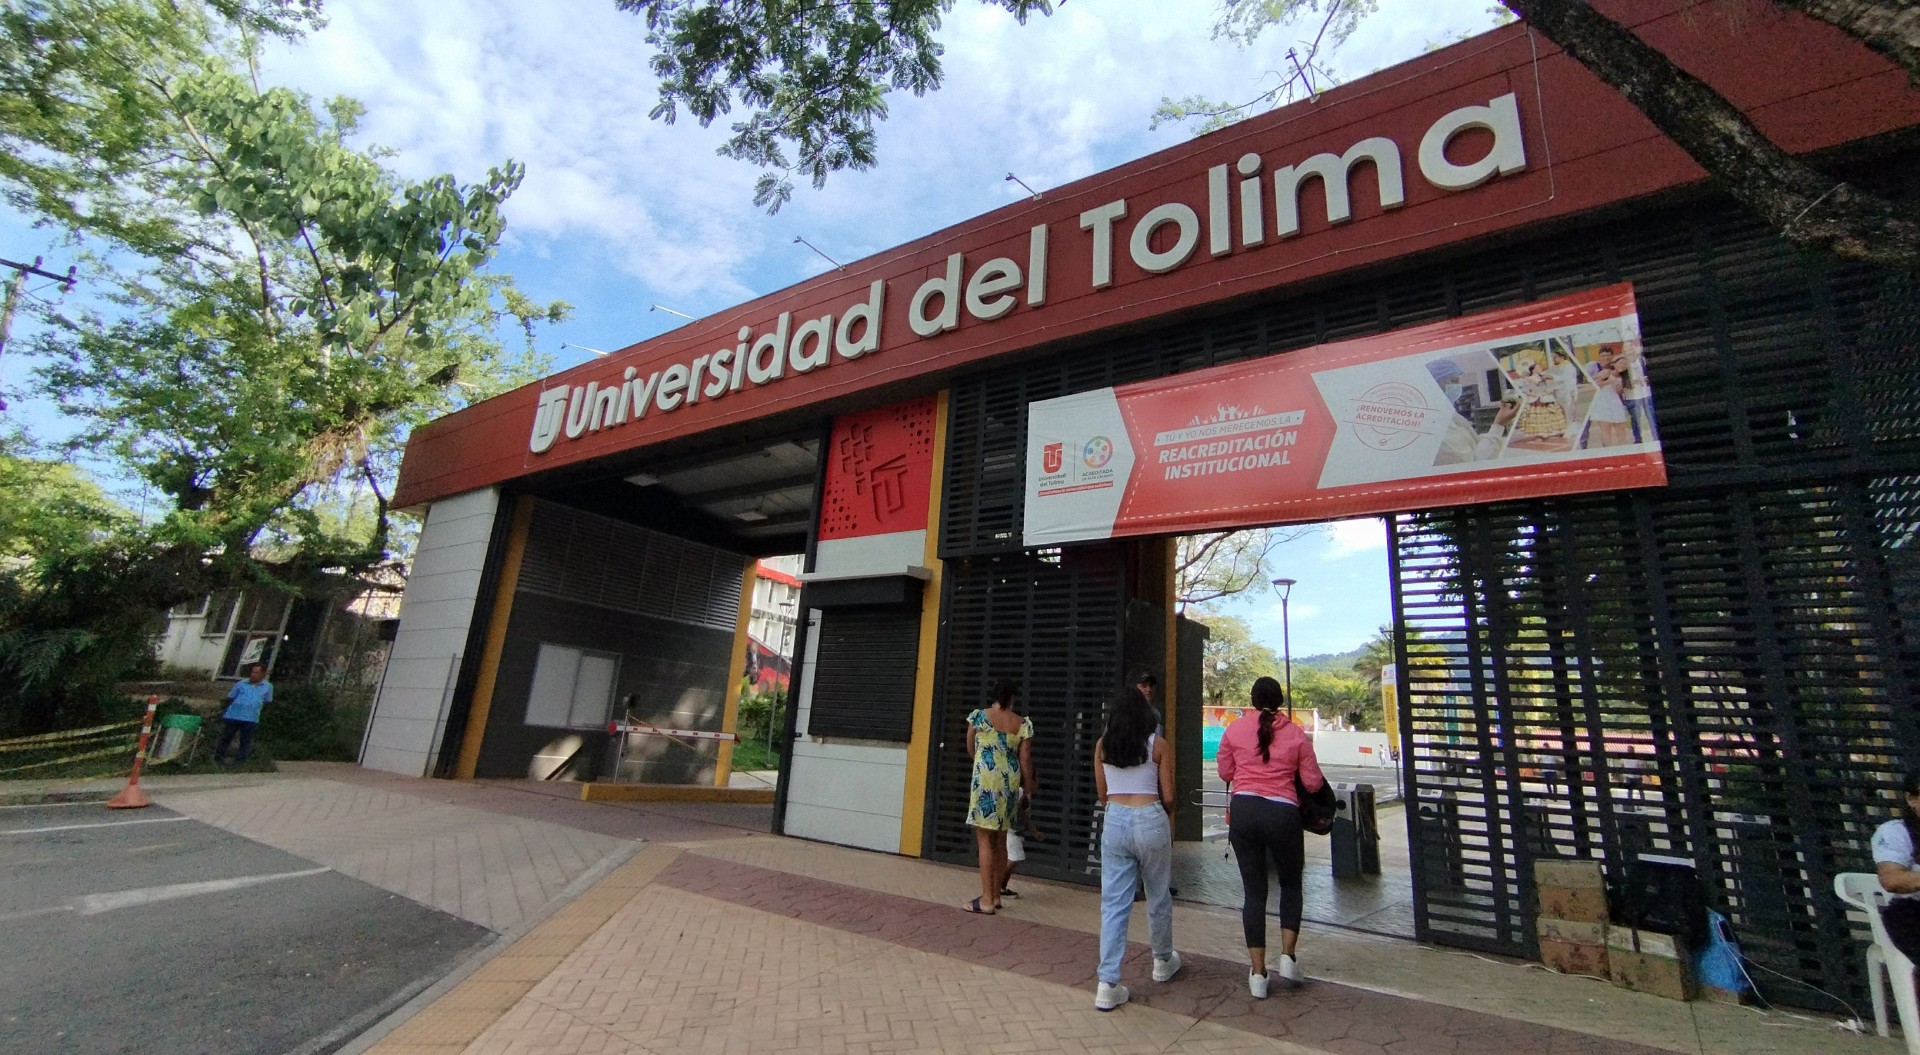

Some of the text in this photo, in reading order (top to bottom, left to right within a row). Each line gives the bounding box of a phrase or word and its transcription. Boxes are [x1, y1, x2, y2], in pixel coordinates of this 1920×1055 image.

[566, 279, 886, 440] Universidad
[909, 223, 1048, 338] del
[1080, 92, 1526, 288] Tolima
[1355, 413, 1421, 428] ACREDITACIÓN!
[1356, 404, 1425, 419] ¡RENOVEMOS LA
[1178, 432, 1185, 441] Y
[1186, 430, 1197, 439] YO
[1199, 426, 1217, 437] NOS
[1219, 417, 1278, 433] MERECEMOS
[1279, 415, 1291, 424] LA
[1159, 429, 1298, 464] REACREDITACIÓN
[1038, 473, 1067, 482] Universidad
[1164, 450, 1292, 480] INSTITUCIONAL
